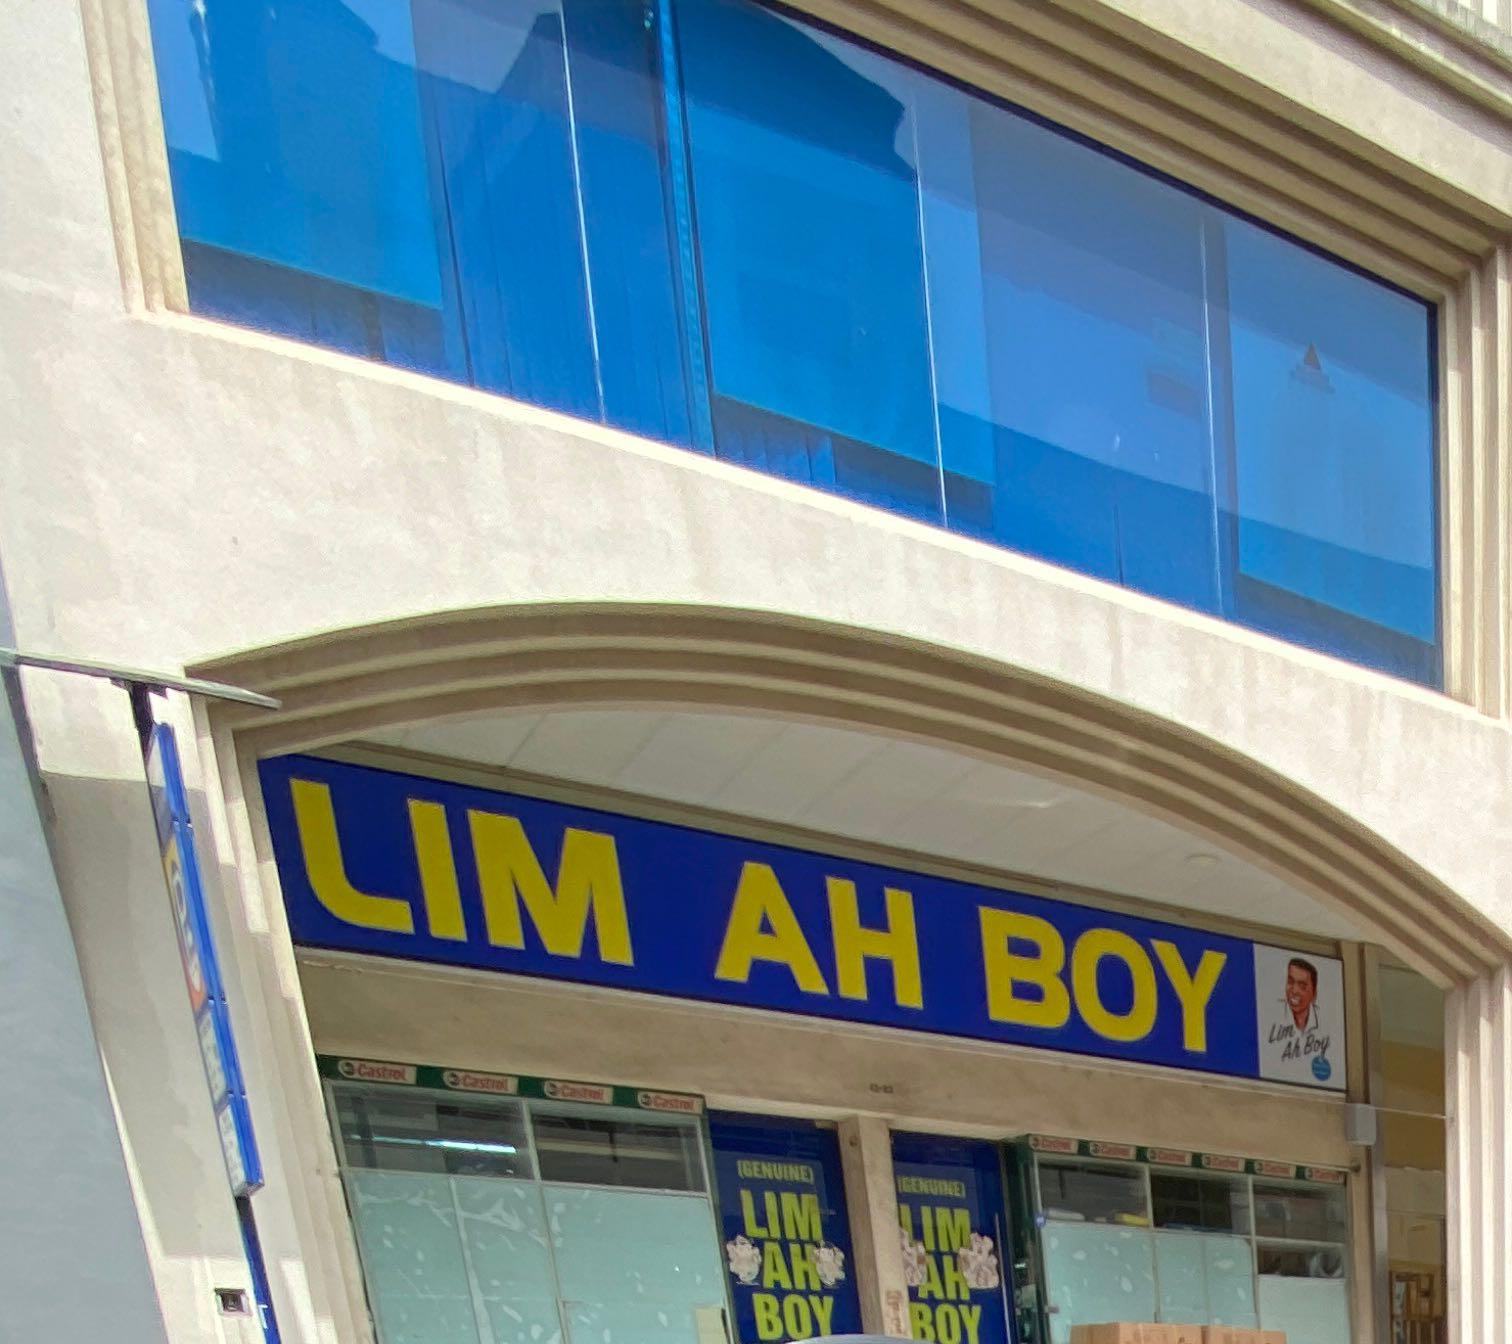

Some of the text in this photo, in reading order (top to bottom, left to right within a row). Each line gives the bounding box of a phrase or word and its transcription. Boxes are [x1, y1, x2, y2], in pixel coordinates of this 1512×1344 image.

[289, 779, 634, 967] LIM
[715, 861, 924, 1009] AH
[980, 906, 1227, 1053] BOY
[1268, 1023, 1295, 1044] Lim
[1281, 1034, 1330, 1062] Ah Boy
[741, 1189, 823, 1242] LIM
[763, 1242, 821, 1290] AH
[918, 1253, 970, 1301] AH
[752, 1293, 834, 1341] BOY
